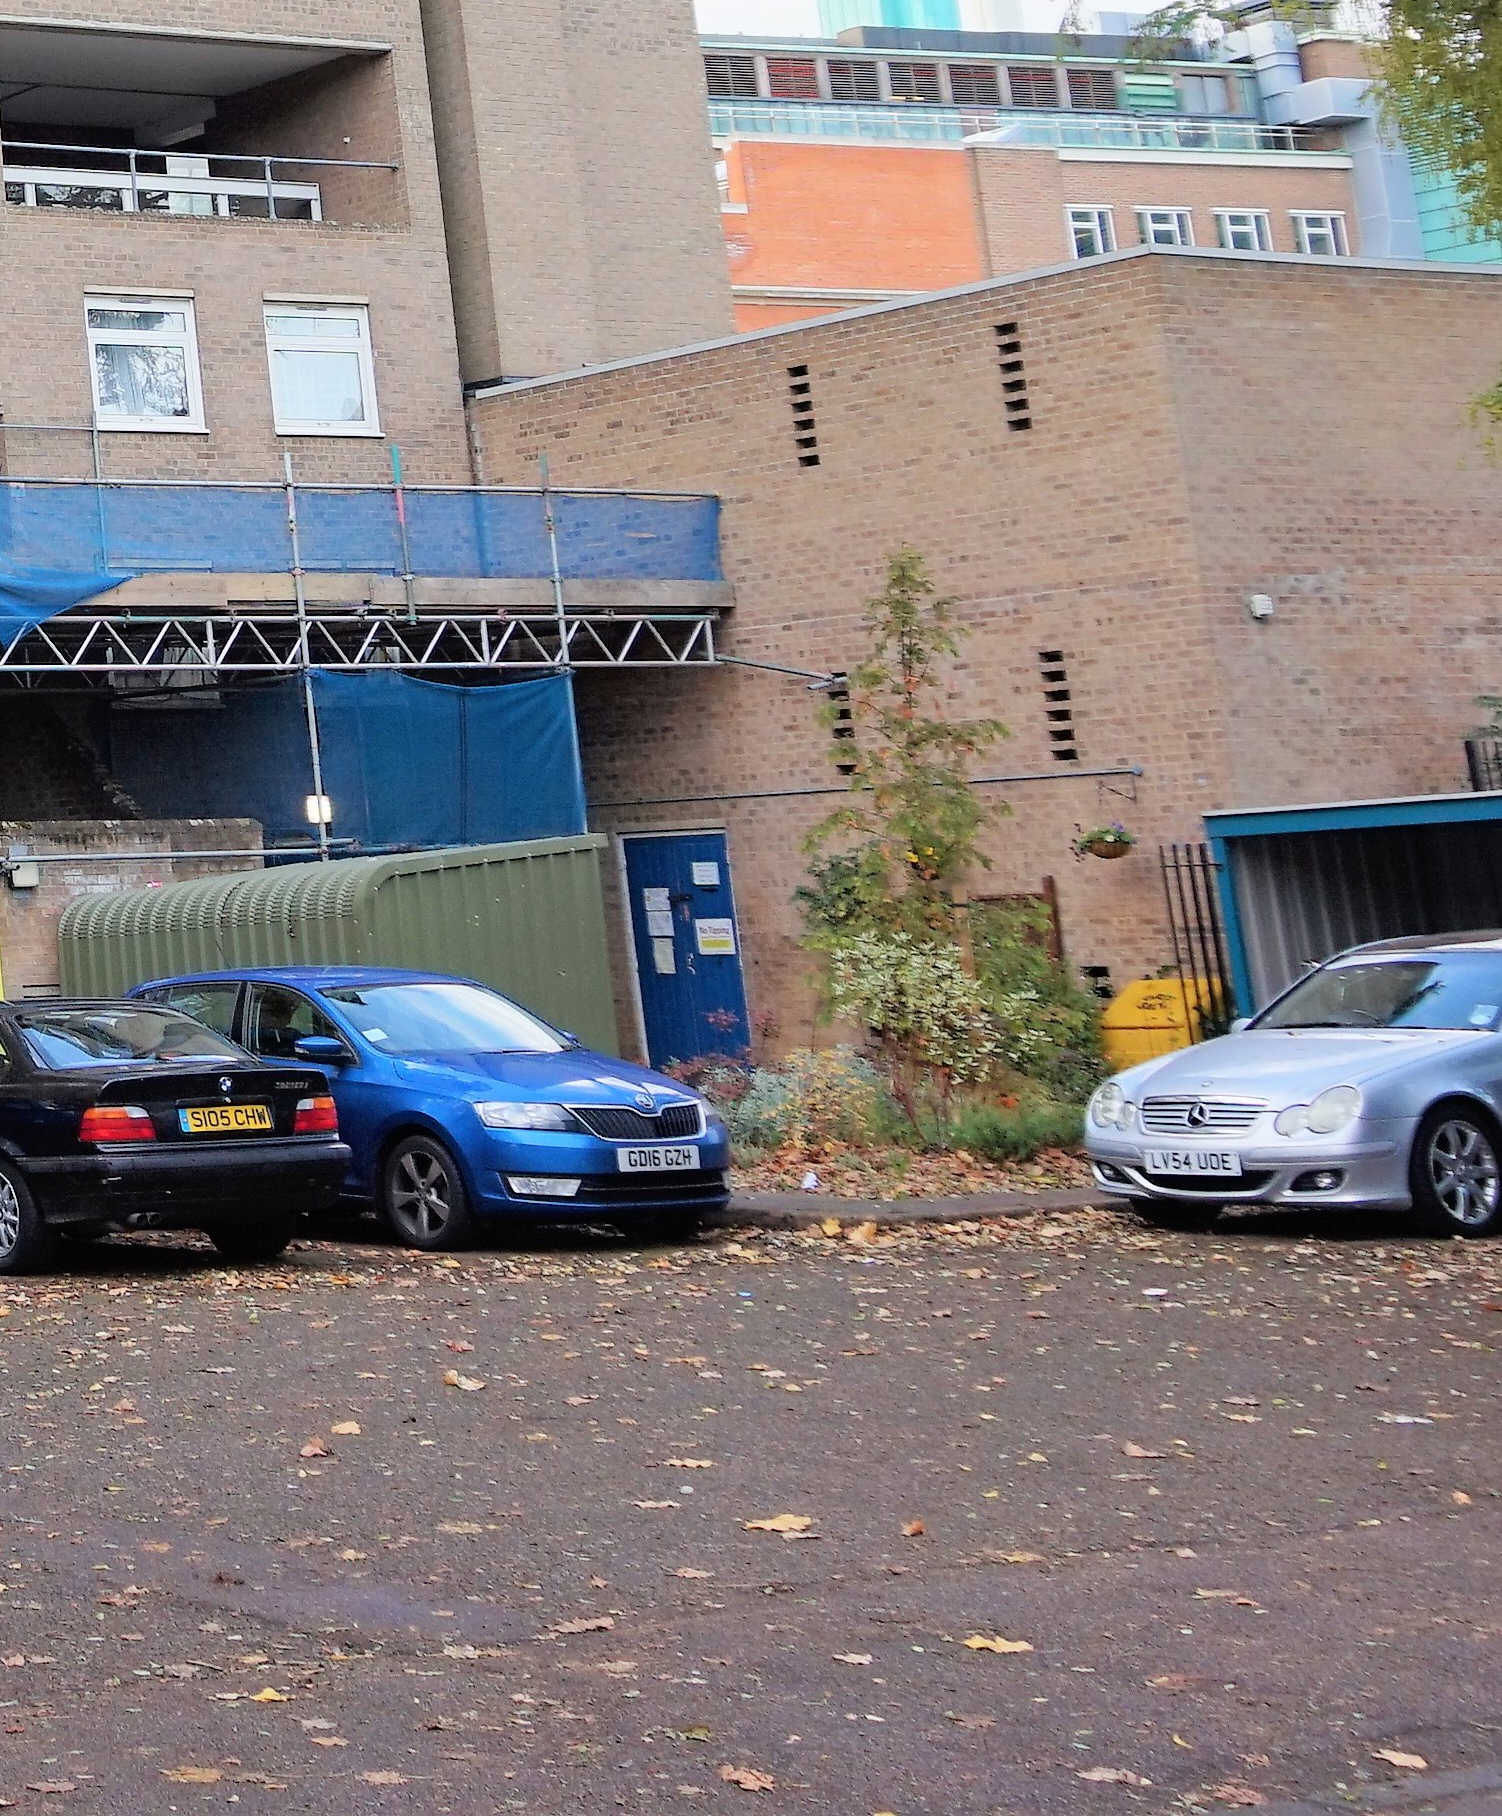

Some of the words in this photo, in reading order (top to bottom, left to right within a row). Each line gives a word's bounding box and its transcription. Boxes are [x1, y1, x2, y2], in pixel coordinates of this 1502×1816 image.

[233, 1108, 267, 1127] CHW
[628, 1150, 661, 1167] GD16
[664, 1148, 693, 1166] GZH
[1150, 1152, 1191, 1170] LV54
